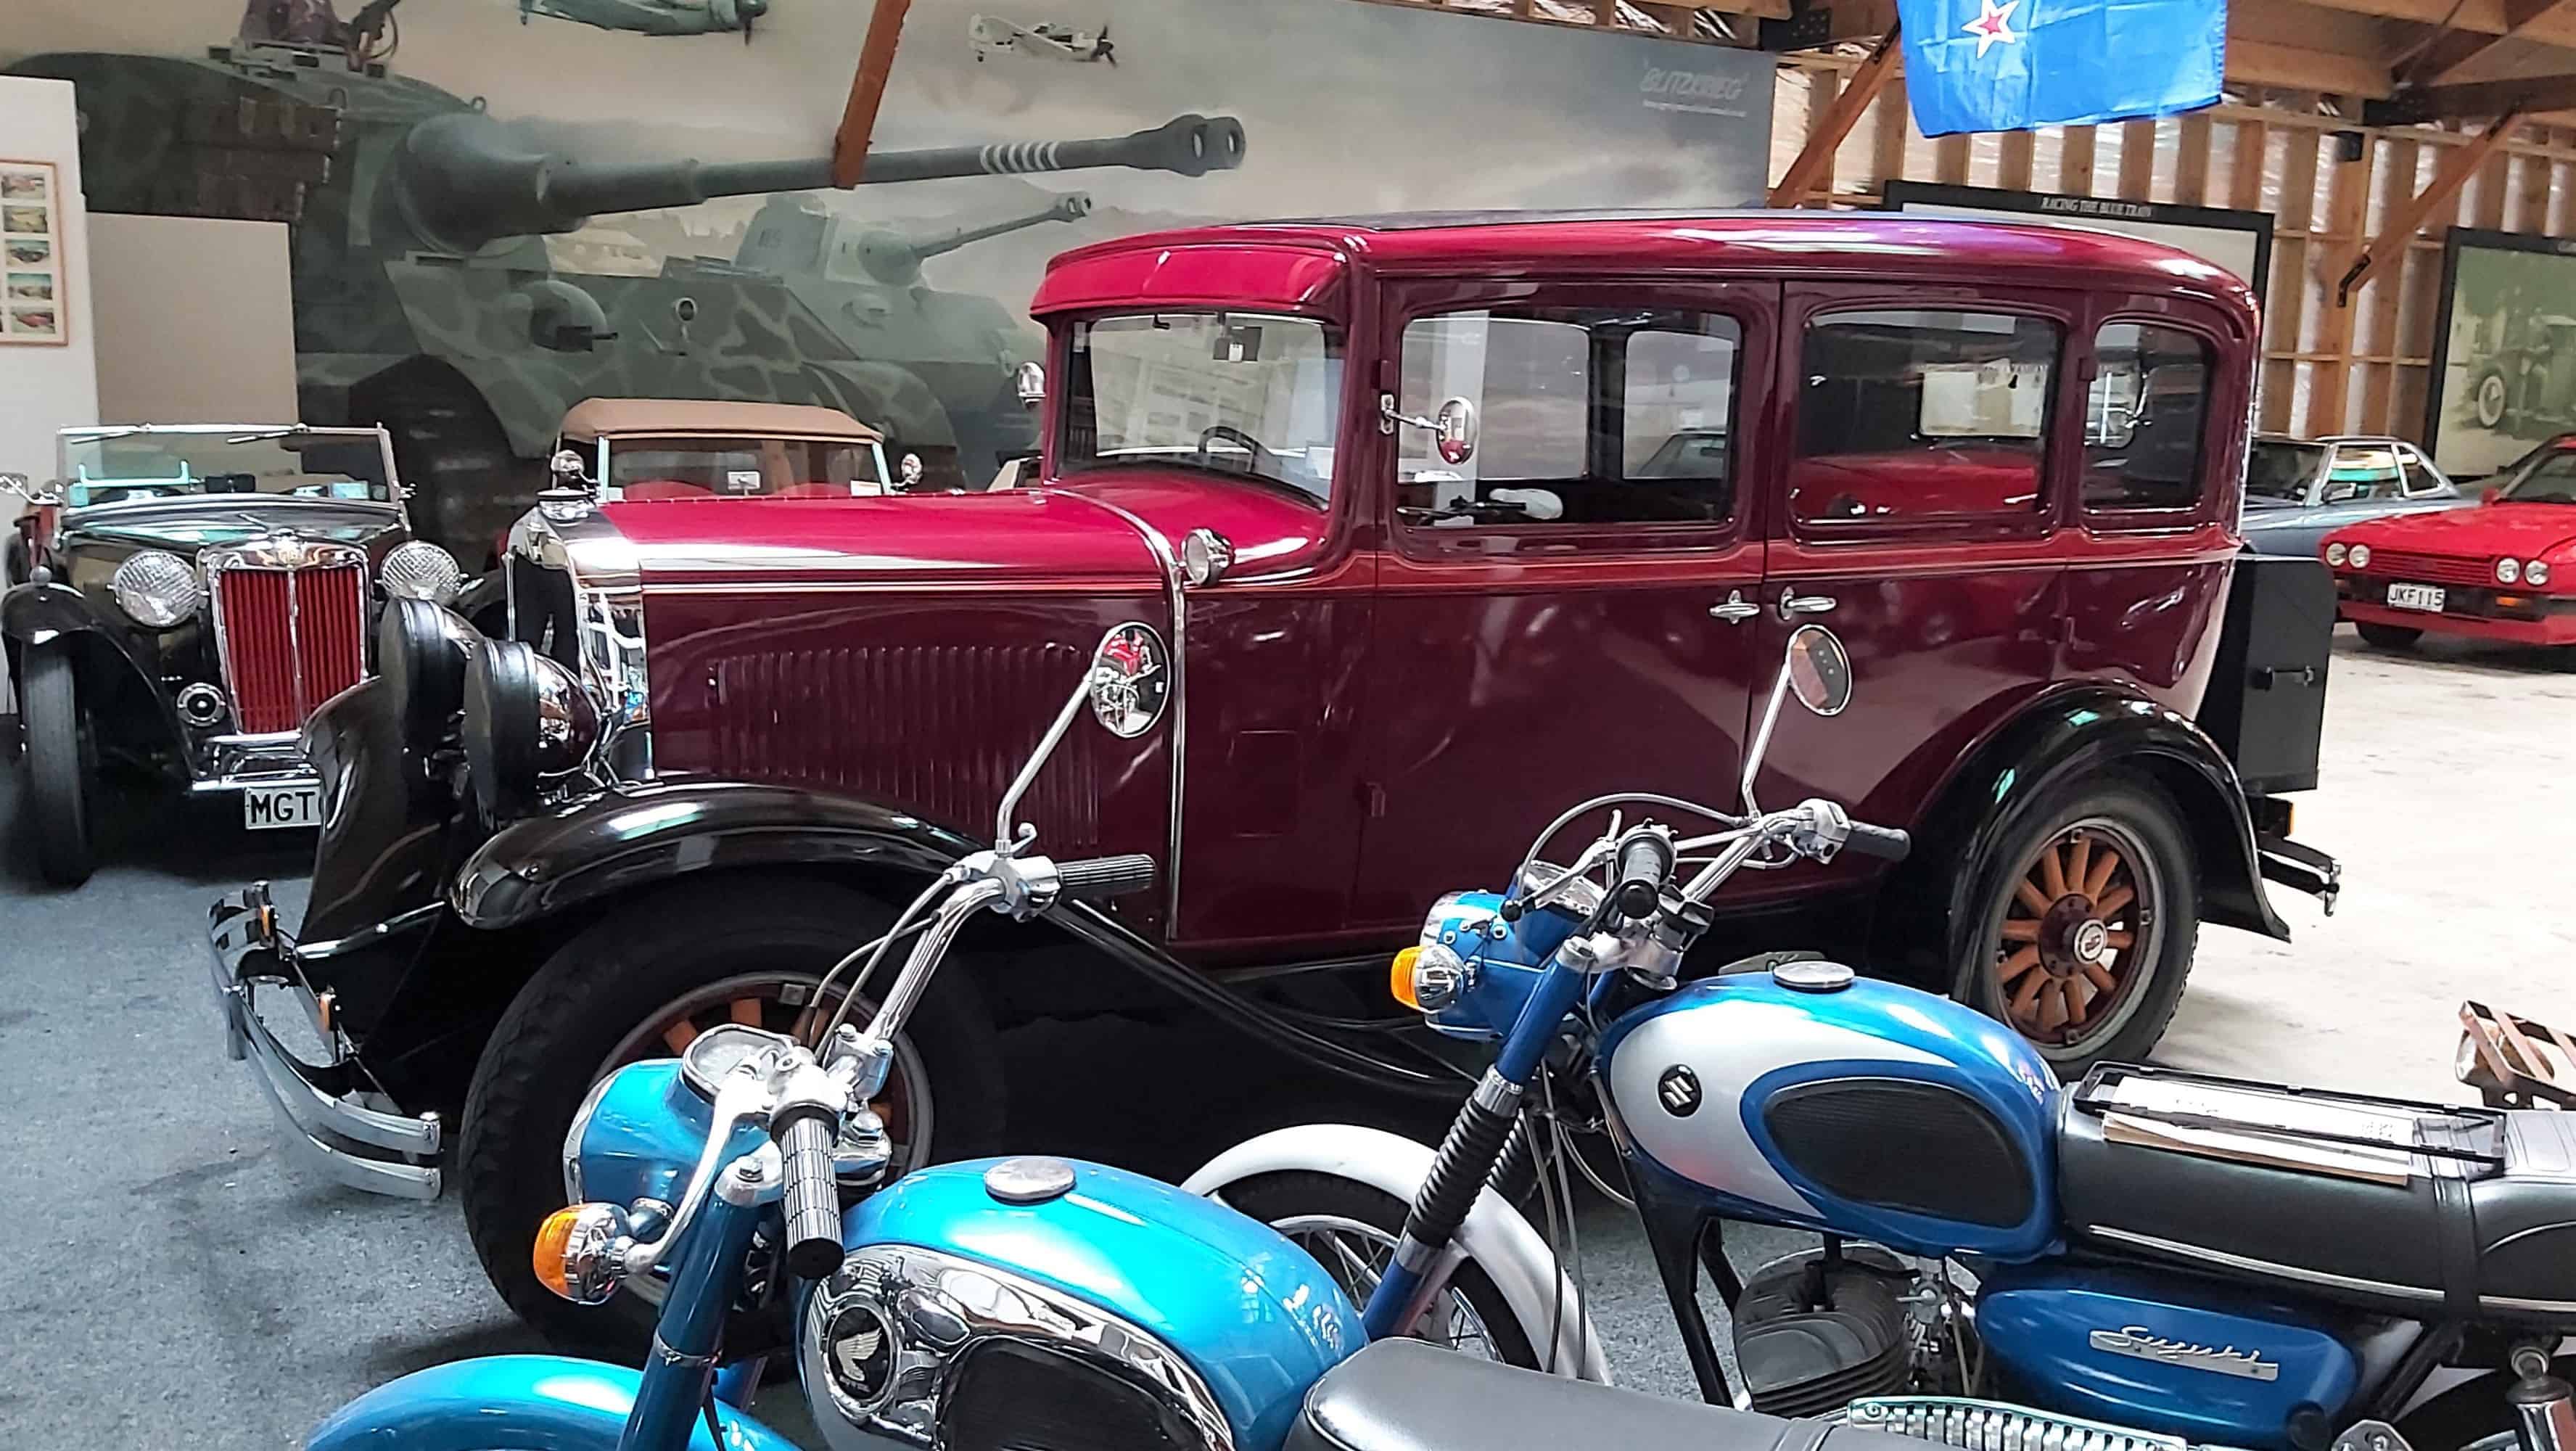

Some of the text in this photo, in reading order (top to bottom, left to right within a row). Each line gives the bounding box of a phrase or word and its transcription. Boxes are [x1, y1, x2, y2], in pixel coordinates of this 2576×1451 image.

[2041, 197, 2079, 212] RACING
[2390, 588, 2443, 607] JKF115
[250, 791, 322, 823] MGT
